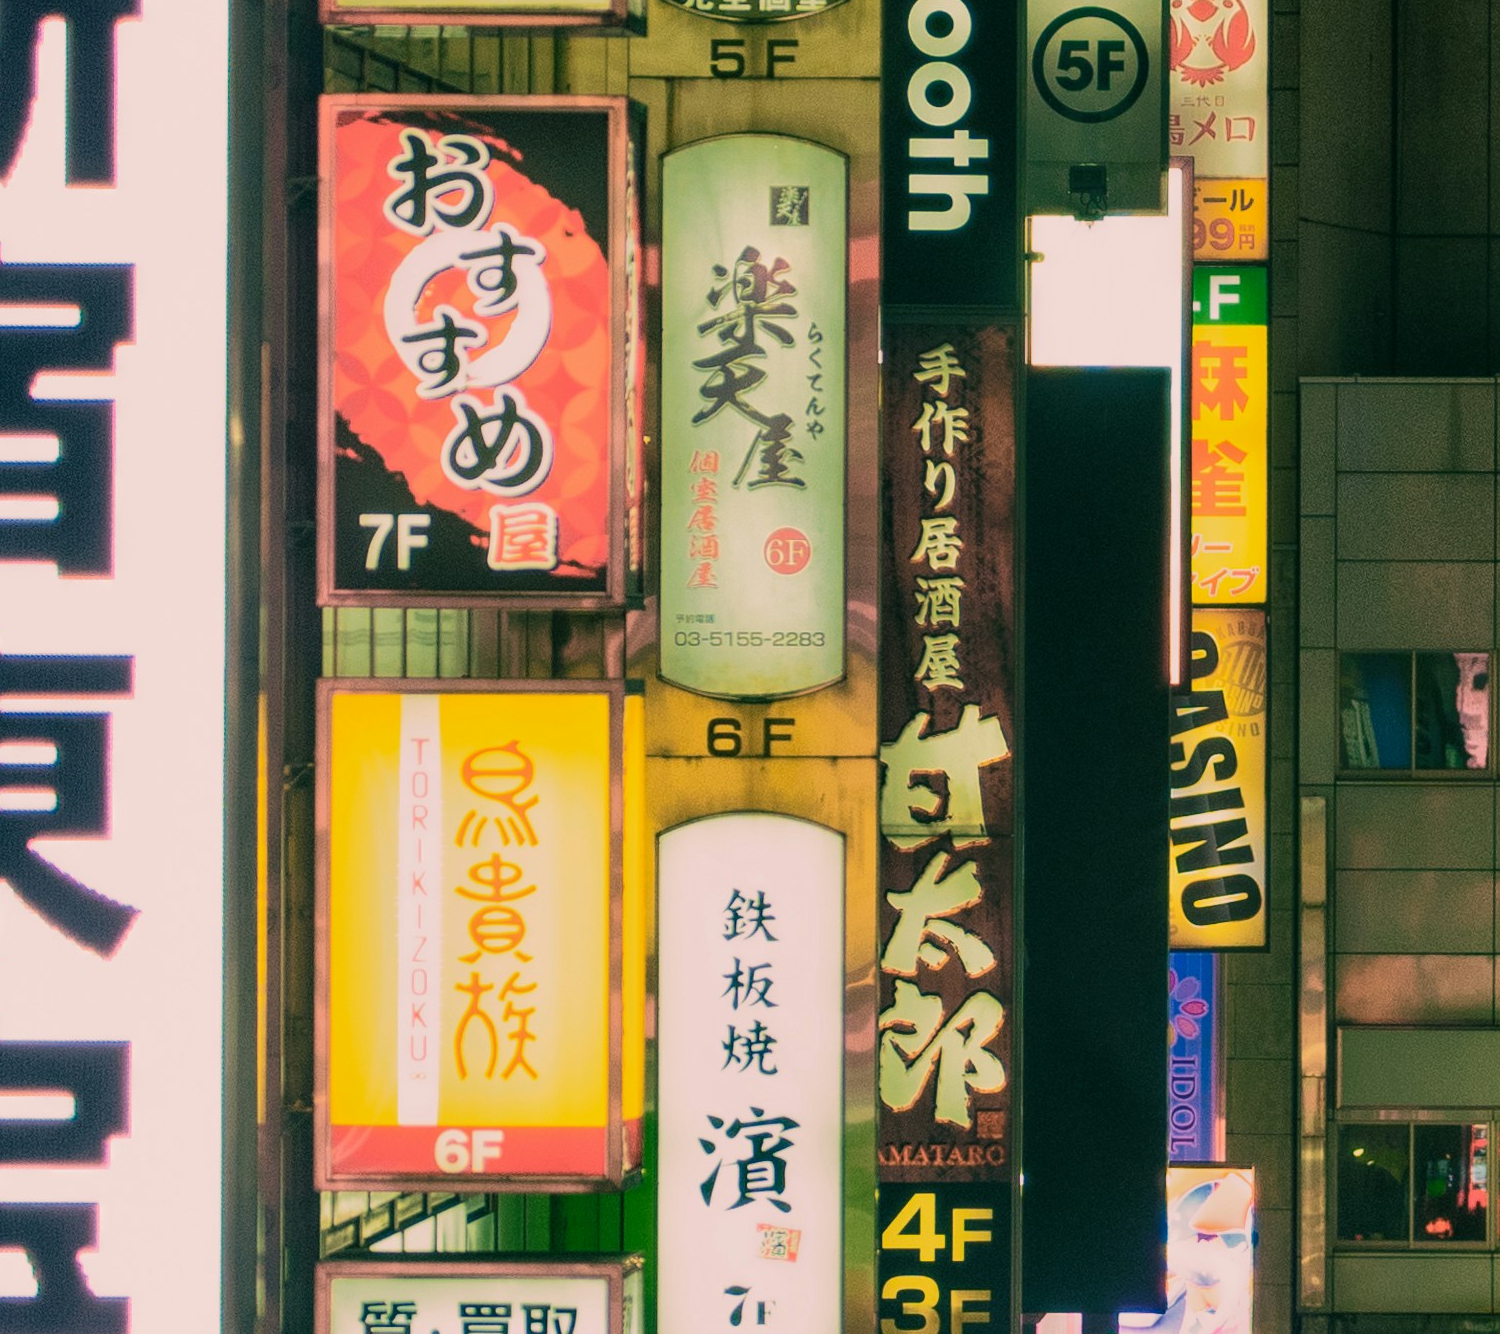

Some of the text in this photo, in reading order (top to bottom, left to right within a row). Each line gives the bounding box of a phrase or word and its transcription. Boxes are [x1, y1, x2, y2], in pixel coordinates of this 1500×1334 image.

[1180, 95, 1226, 108] 三代目
[692, 245, 806, 489] 楽天屋
[805, 322, 827, 441] らくてんや
[1192, 340, 1251, 518] 麻雀
[359, 513, 431, 570] 7F
[687, 449, 720, 589] 個室居酒屋
[910, 342, 969, 693] 手作り居酒屋
[674, 630, 826, 647] 03-5155-2283
[707, 717, 797, 757] 6F
[411, 738, 429, 1062] TORIKIZOKU
[454, 739, 539, 1081] 鳥貴族
[879, 703, 1012, 1131] 甘太郎
[722, 888, 780, 1076] 鉄板焼
[434, 1130, 505, 1173] 6F
[698, 1105, 802, 1213] 濱
[881, 1192, 994, 1263] 4F
[723, 1285, 776, 1327] 7F
